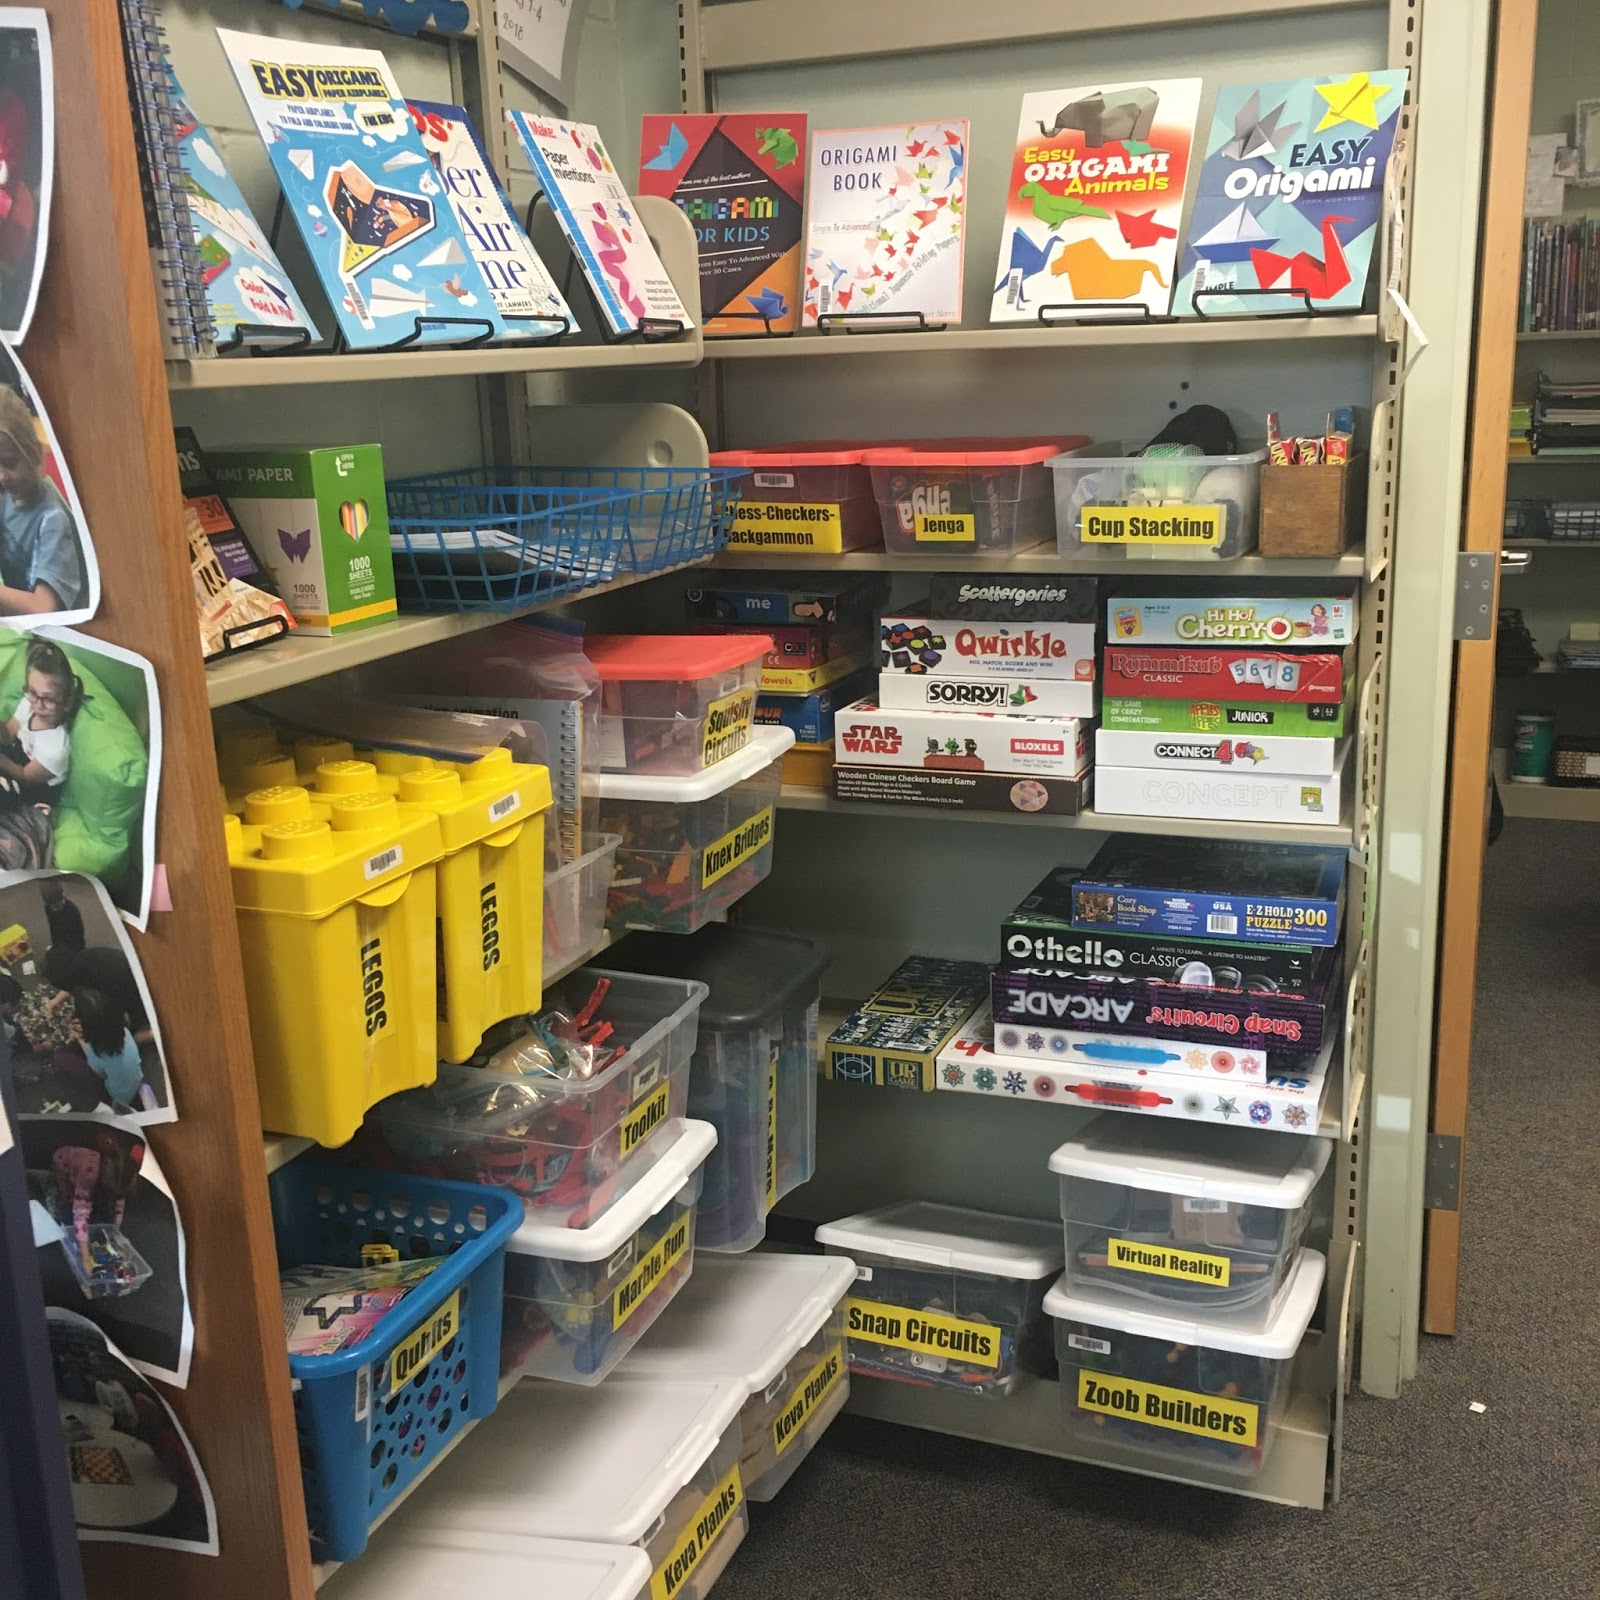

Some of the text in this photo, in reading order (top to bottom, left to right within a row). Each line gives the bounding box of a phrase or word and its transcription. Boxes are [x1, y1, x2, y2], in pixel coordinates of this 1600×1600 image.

[251, 64, 381, 97] EASY ORIGAMI
[323, 89, 345, 98] PAPER
[287, 104, 305, 114] PAPER
[377, 113, 394, 126] KIDS
[541, 148, 569, 165] Paper
[821, 145, 897, 166] ORIGAMI
[1023, 147, 1075, 164] Easy
[1289, 136, 1373, 168] EASY
[551, 165, 596, 183] Inventions
[1024, 153, 1170, 183] ORIGAMI
[834, 172, 882, 191] BOOK
[1064, 171, 1170, 196] Animals
[1224, 156, 1376, 204] Origami
[457, 202, 517, 251] Air
[724, 226, 770, 243] KIDS
[812, 222, 870, 232] Simple To Advanced
[712, 257, 728, 267] Easy
[729, 256, 738, 265] To
[739, 254, 770, 264] Advanced
[890, 234, 960, 295] Japanese Folding Papers
[723, 266, 742, 274] Cases
[248, 467, 294, 482] PAPER
[922, 517, 964, 535] Jenga
[1088, 516, 1214, 539] Cup Stacking
[349, 556, 371, 572] 1000
[349, 568, 373, 581] SHEETS
[294, 584, 316, 593] 1000
[958, 584, 1067, 606] Scattergories
[746, 598, 771, 610] me
[1207, 608, 1253, 622] Hi Ho!
[1178, 615, 1292, 640] Cherry-O
[955, 628, 1067, 659] Qwirkle
[1112, 654, 1222, 677] Rummikub
[1235, 664, 1293, 682] 5 6 7 8
[1143, 674, 1182, 683] CLASSIC
[929, 682, 1006, 704] SORRY!
[1232, 711, 1268, 723] JUNIOR
[842, 725, 902, 741] STAR
[704, 725, 747, 766] Circuits
[843, 739, 902, 754] WARS
[1014, 742, 1059, 752] BLOXELS
[1157, 740, 1232, 763] CONNECT 4
[837, 771, 976, 786] Wooden Chinese Checkers Board Game
[1142, 781, 1289, 808] CONCEPT
[706, 814, 770, 878] Knex Bridges
[1117, 895, 1137, 905] Cozy
[1213, 903, 1232, 911] USA
[1117, 904, 1156, 915] Book Shop
[1246, 904, 1293, 918] E-Z HOLD
[1294, 908, 1327, 926] 300
[480, 881, 500, 972] LEGOS
[1246, 916, 1292, 930] PUZZLE
[1007, 934, 1124, 968] Othello
[1129, 952, 1187, 968] CLASSIC
[360, 938, 387, 1037] LEGOS
[1007, 988, 1135, 1023] ARCADE
[1150, 1006, 1240, 1034] Circuits
[1244, 1012, 1301, 1041] Snap
[889, 1062, 917, 1079] UR
[888, 1077, 917, 1086] GAME
[625, 1093, 666, 1150] Toolkit
[619, 1225, 685, 1316] Marble Run
[1116, 1245, 1223, 1279] Virtual Reality
[849, 1307, 991, 1356] Snap Circuits
[775, 1355, 838, 1444] Keva Planks
[1084, 1379, 1247, 1436] Zoob Builders
[664, 1483, 736, 1596] Keva Planks
